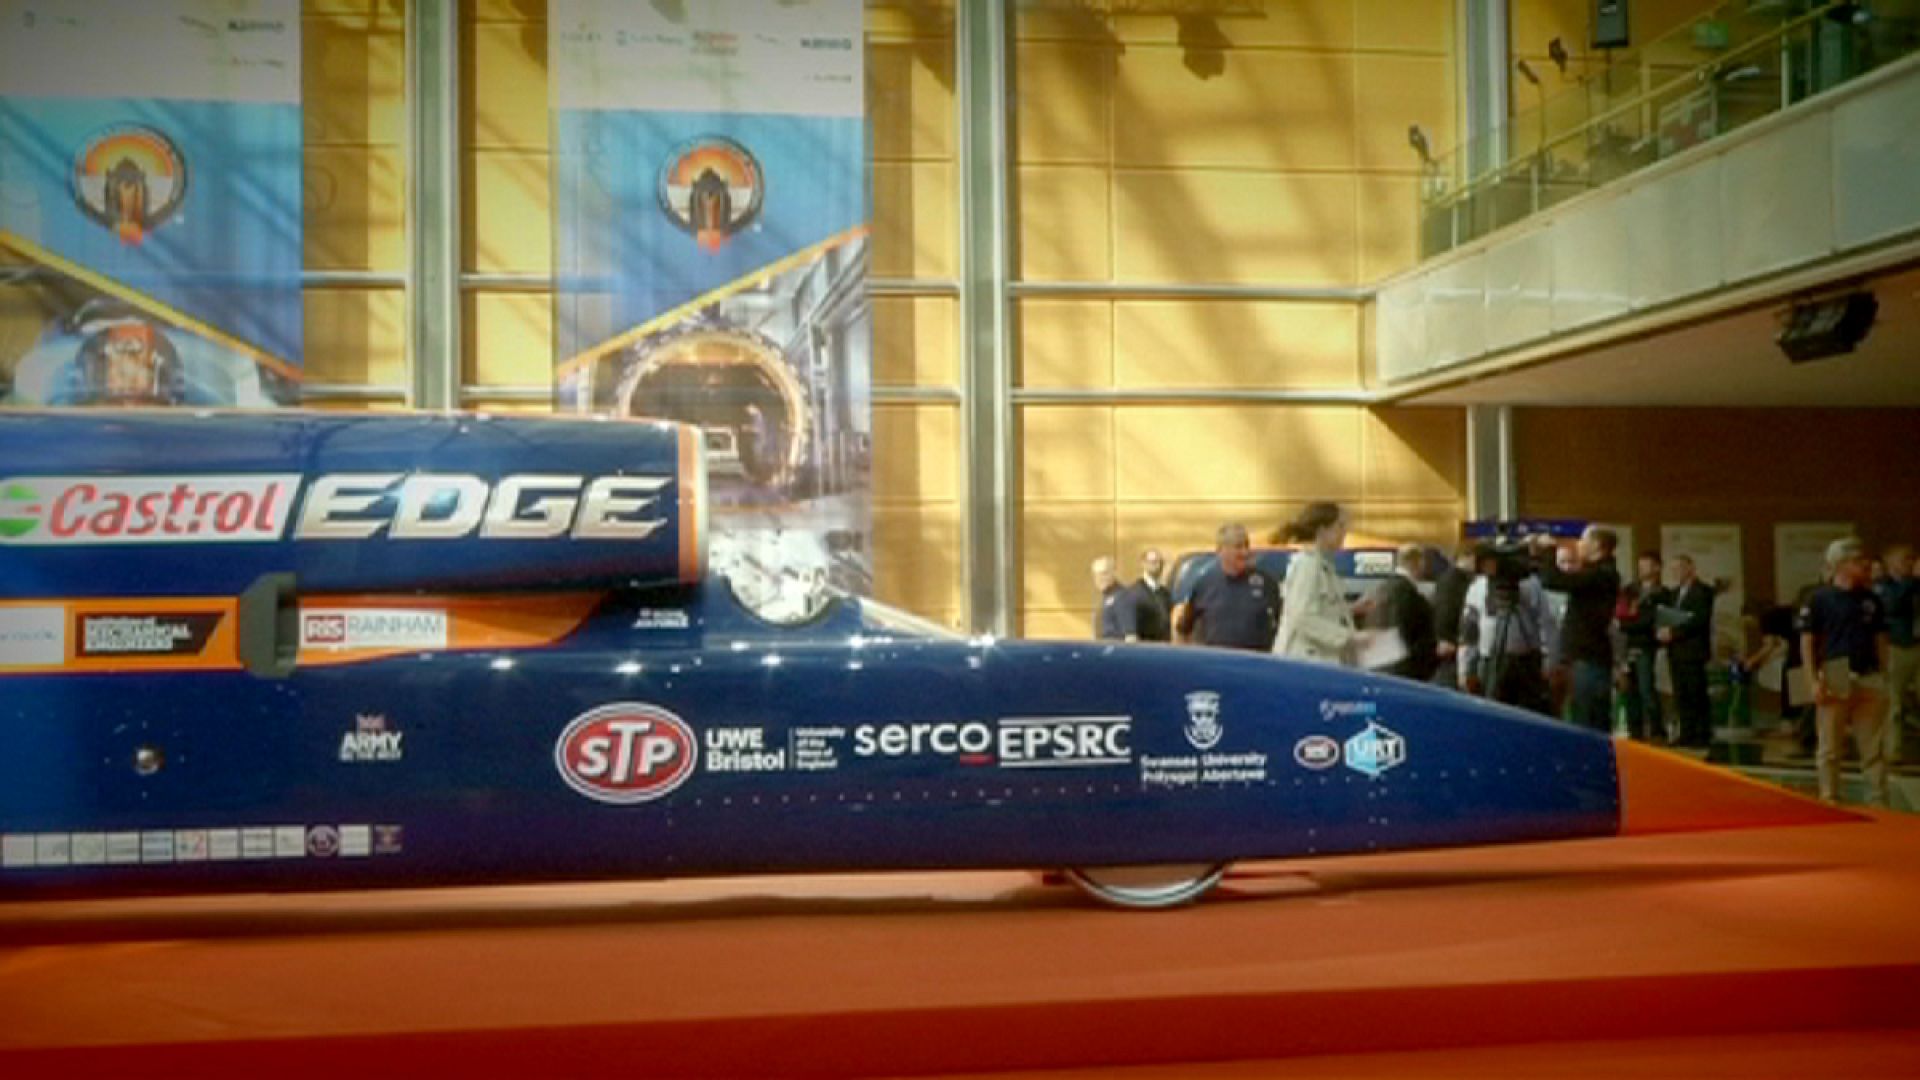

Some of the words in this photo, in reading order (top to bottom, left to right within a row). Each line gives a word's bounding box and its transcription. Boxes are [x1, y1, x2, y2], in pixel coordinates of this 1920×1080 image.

[50, 482, 279, 538] Castrol
[294, 473, 674, 540] EDGE
[348, 615, 442, 634] RAINHAM
[577, 721, 676, 783] STP
[705, 727, 763, 749] UWE
[854, 722, 991, 756] serco
[1000, 723, 1132, 759] EPSRC
[706, 748, 785, 771] Bristol
